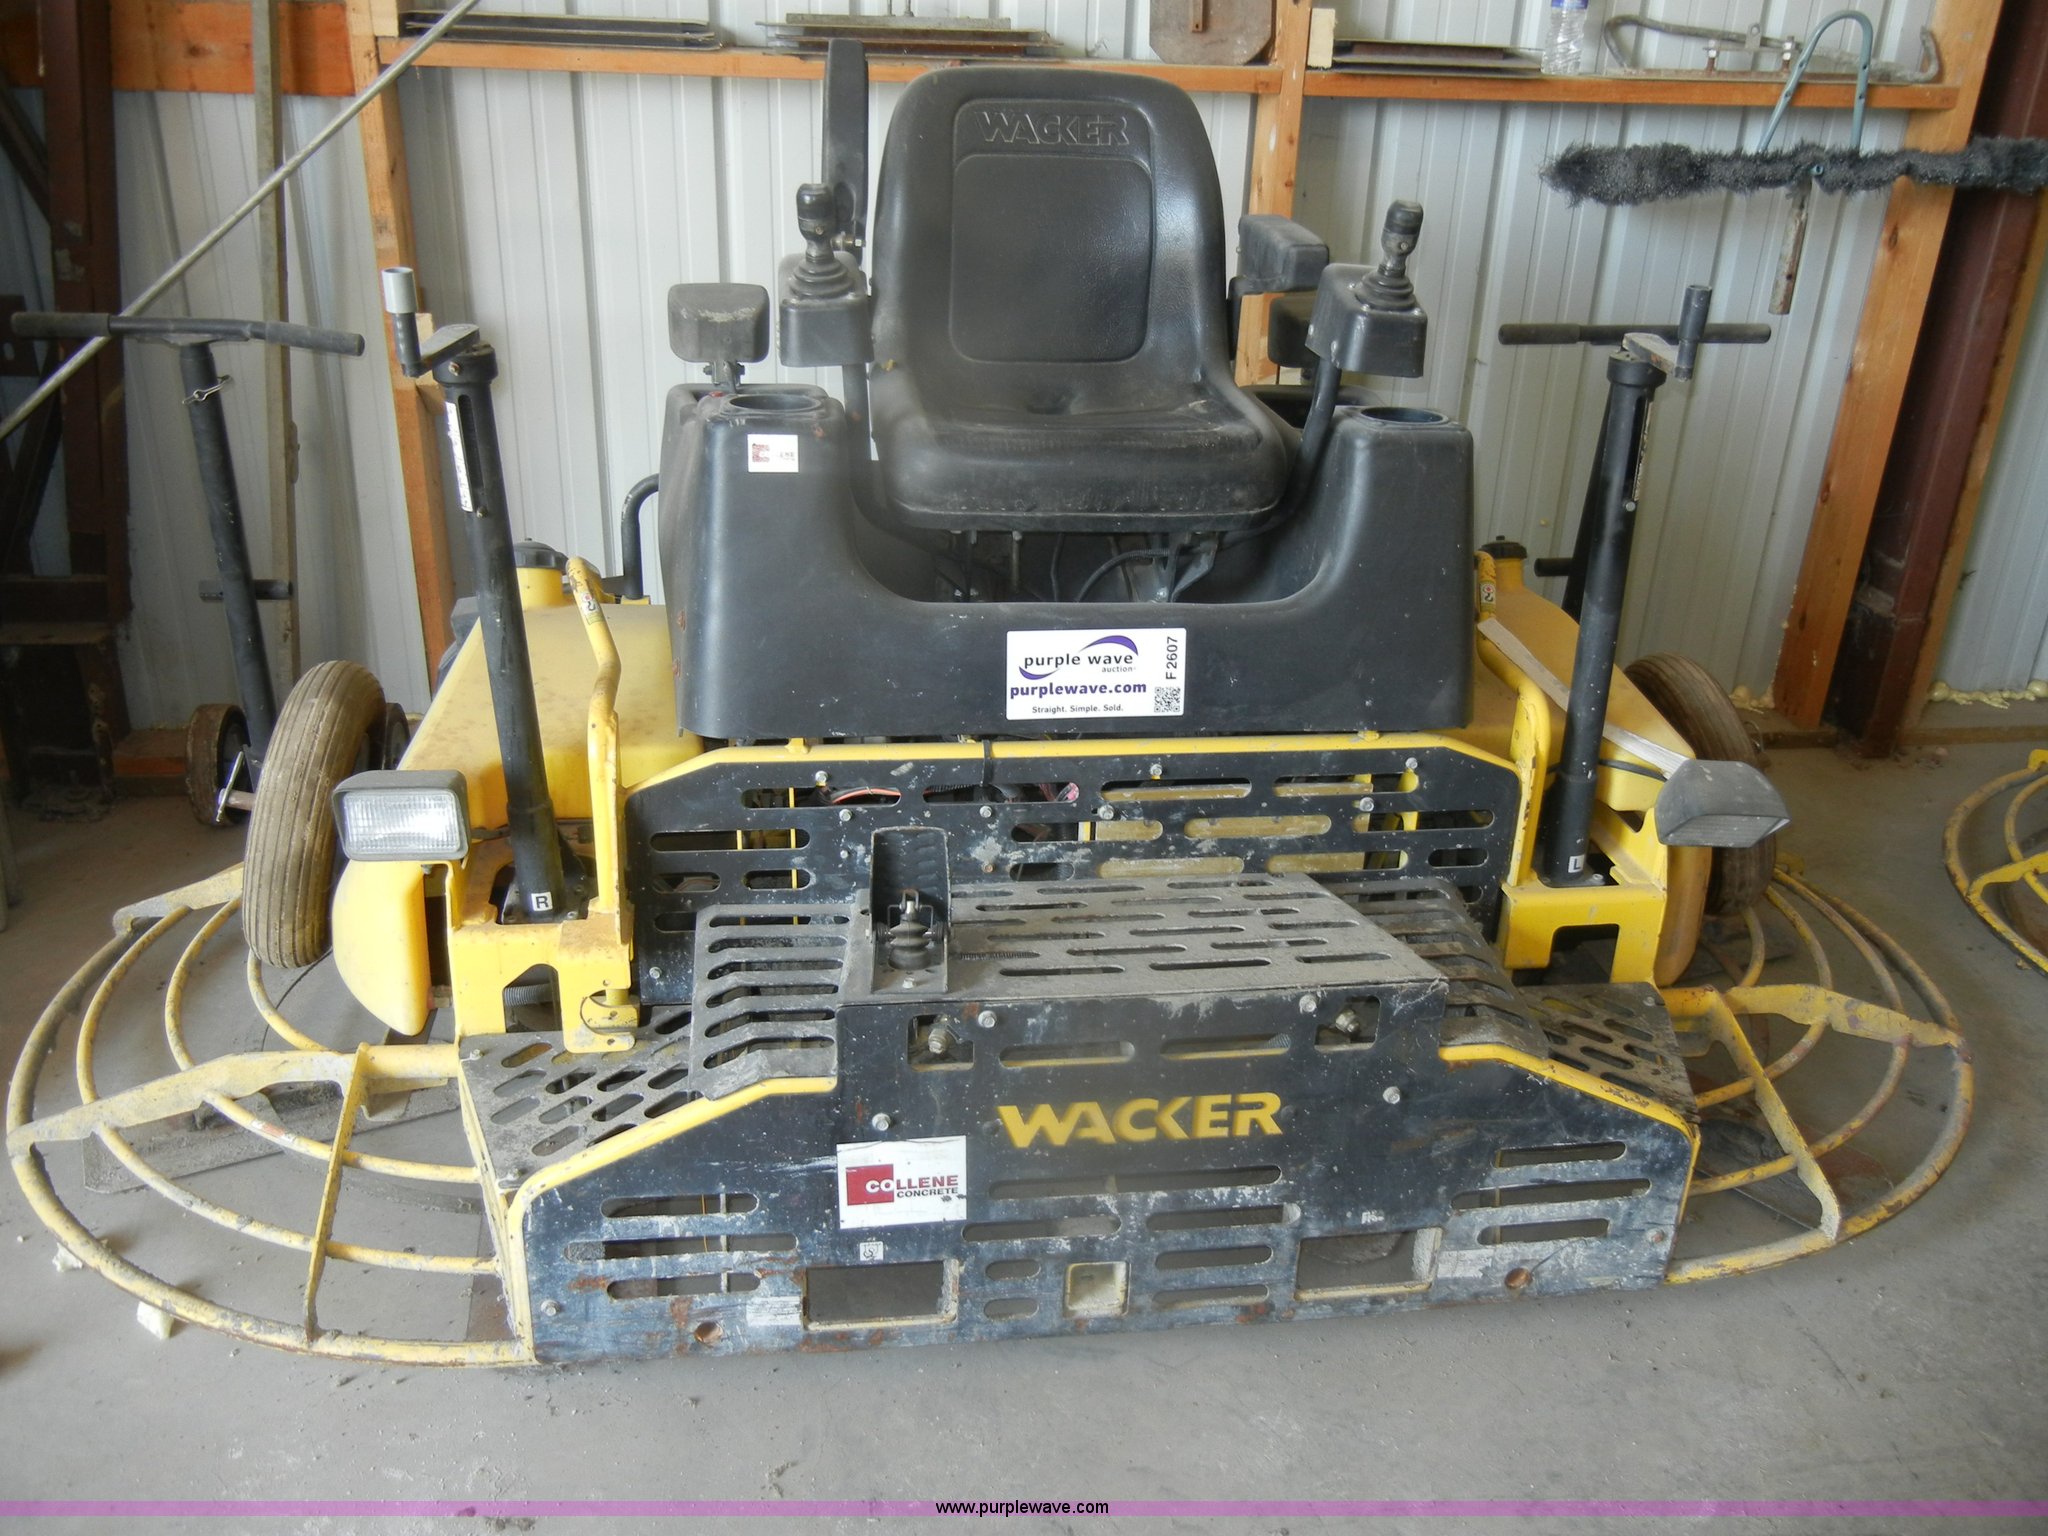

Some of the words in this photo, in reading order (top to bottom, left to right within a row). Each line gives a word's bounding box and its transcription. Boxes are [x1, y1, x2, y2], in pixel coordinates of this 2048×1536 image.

[974, 111, 1129, 146] WACKER
[1024, 653, 1080, 669] purple
[1088, 655, 1133, 665] wave
[1101, 665, 1133, 673] auction
[1010, 682, 1147, 700] purplewave.com
[1032, 705, 1067, 714] Straight.
[1070, 704, 1100, 714] Simple.
[1103, 704, 1124, 712] Sold.
[1573, 858, 1581, 870] L
[535, 895, 549, 909] R
[997, 1091, 1284, 1148] WACKER
[865, 1174, 959, 1194] COLLENE
[896, 1187, 958, 1198] CONCRETE
